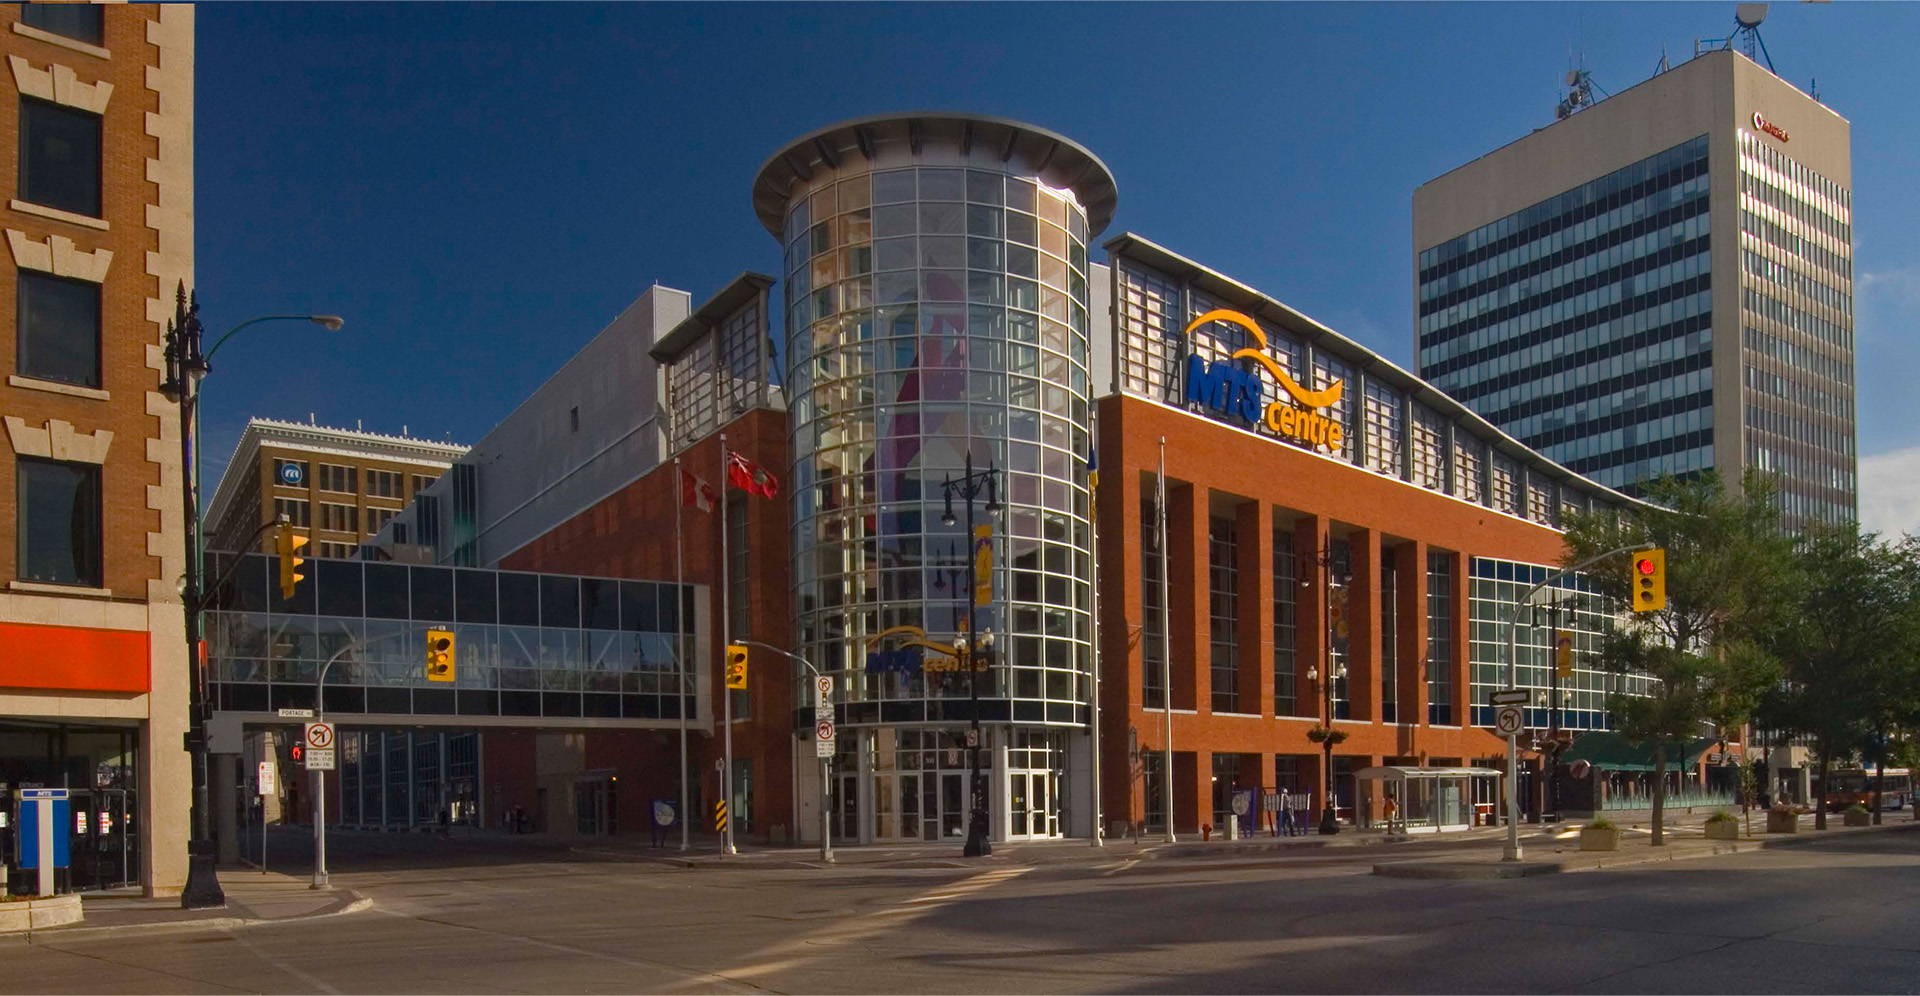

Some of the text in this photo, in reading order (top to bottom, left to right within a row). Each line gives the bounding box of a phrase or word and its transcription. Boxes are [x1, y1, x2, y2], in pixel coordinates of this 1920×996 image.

[1187, 353, 1342, 451] MTS centre
[282, 709, 304, 717] PORTAGE
